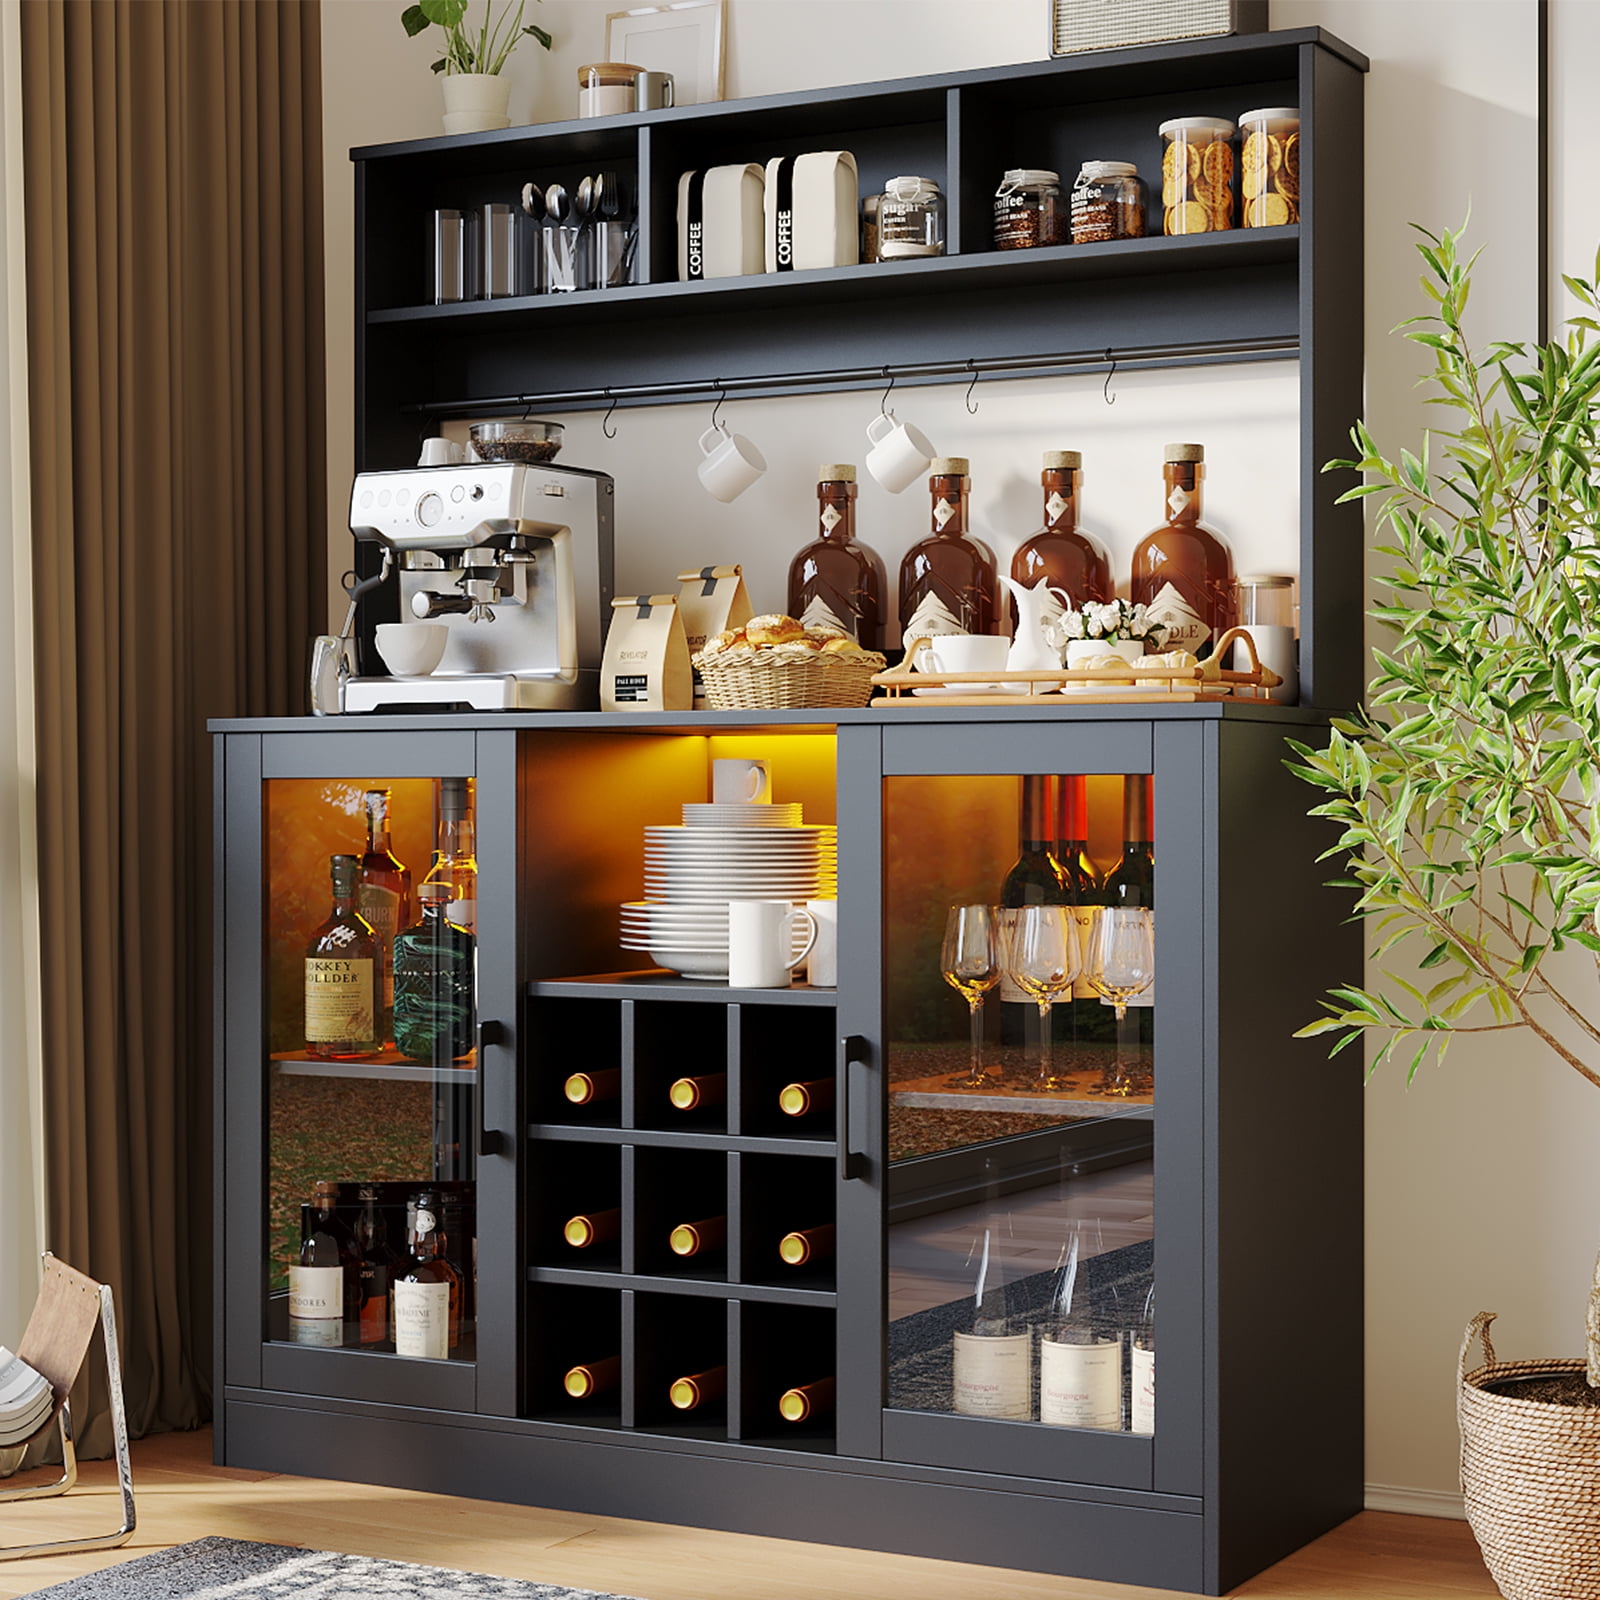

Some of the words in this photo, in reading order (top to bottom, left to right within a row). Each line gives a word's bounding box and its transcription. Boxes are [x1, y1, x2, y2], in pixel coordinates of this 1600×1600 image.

[883, 202, 919, 216] sugar
[689, 221, 702, 276] COFFEE
[778, 209, 791, 265] COFFEE
[1169, 624, 1199, 639] DLE
